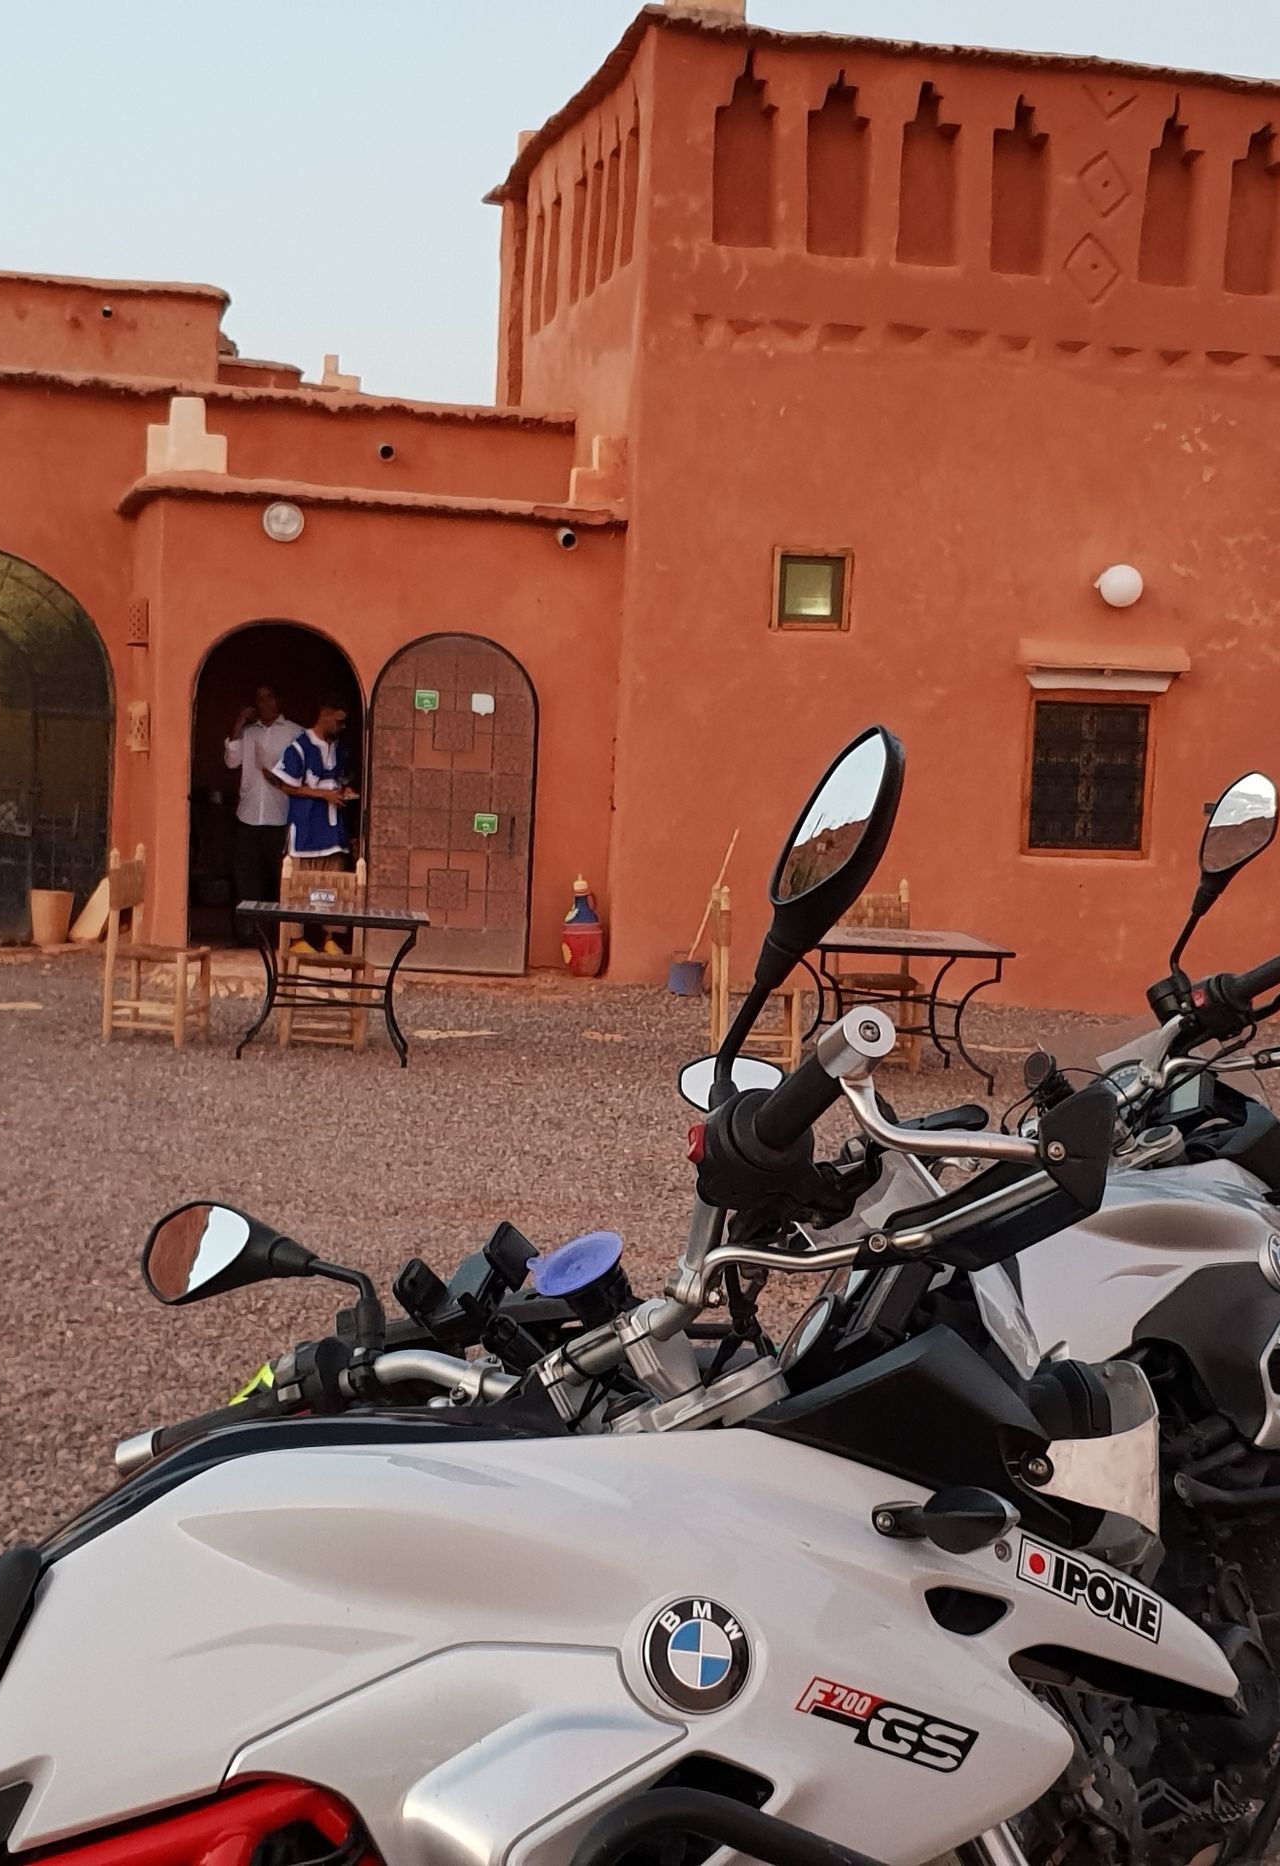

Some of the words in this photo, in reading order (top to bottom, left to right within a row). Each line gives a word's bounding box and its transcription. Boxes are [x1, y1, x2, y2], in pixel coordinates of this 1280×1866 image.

[660, 1601, 743, 1640] BMW
[1052, 1556, 1158, 1637] IPONE
[868, 1707, 970, 1769] GS
